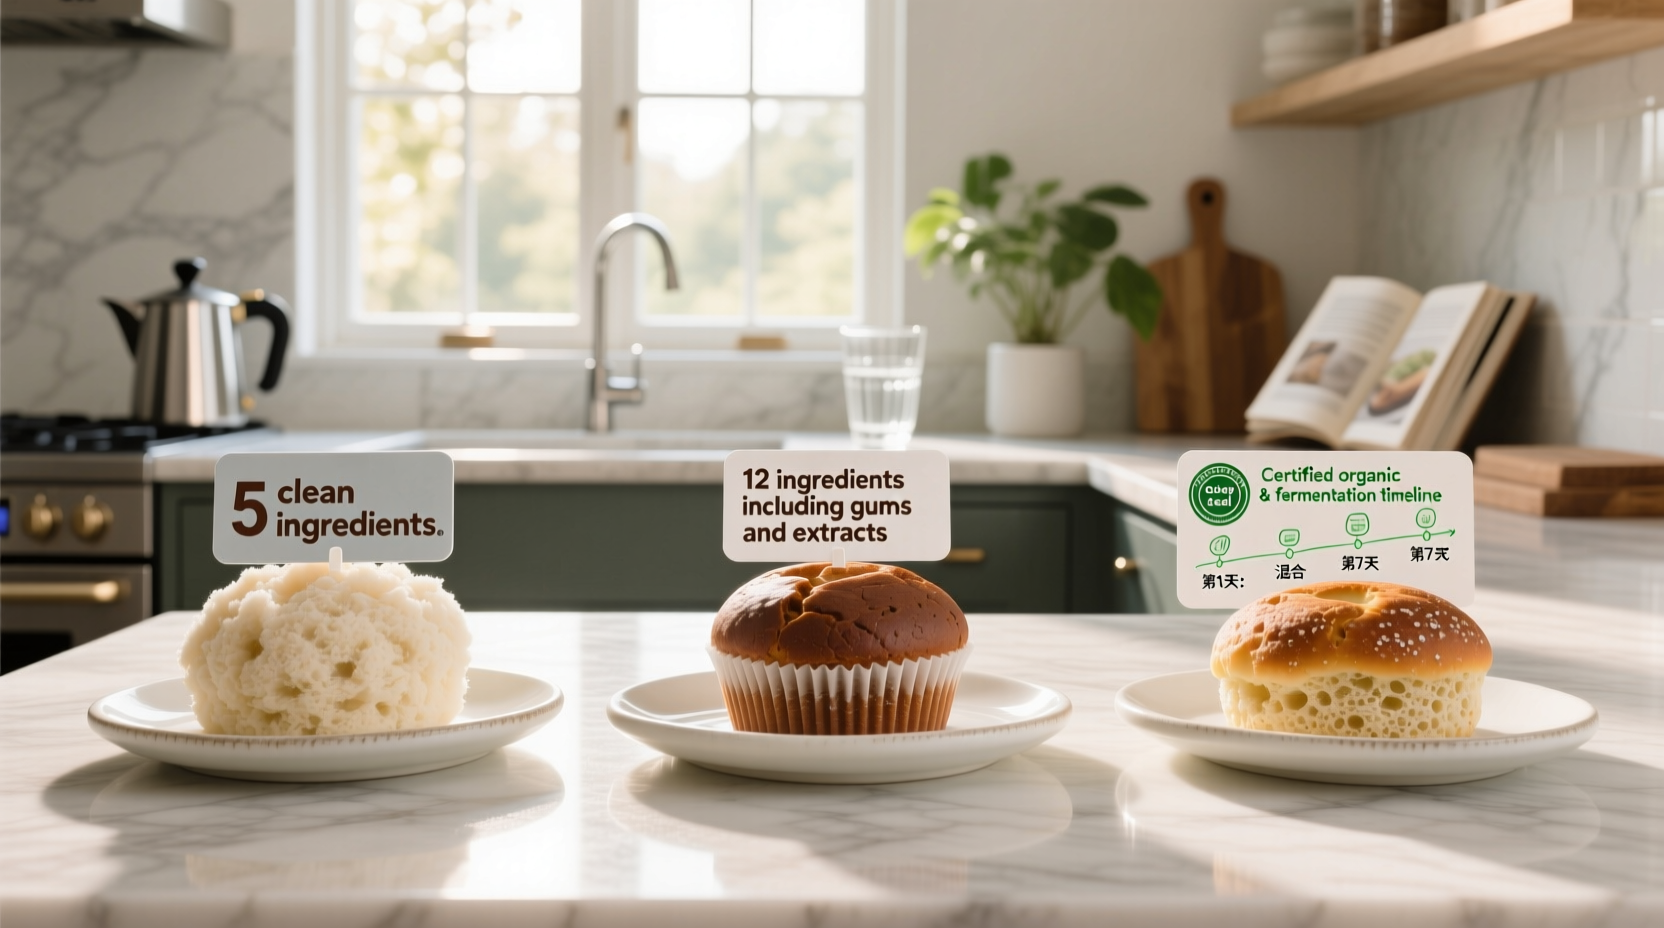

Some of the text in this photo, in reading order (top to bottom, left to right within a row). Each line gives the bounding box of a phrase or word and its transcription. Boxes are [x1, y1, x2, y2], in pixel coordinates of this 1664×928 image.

[742, 468, 904, 494] 12 ingredients
[1261, 466, 1333, 482] Certified
[1338, 466, 1401, 486] organic
[1259, 486, 1443, 502] & fermentation timeline
[232, 478, 354, 537] 5 clean
[742, 495, 912, 521] including gums
[742, 521, 887, 542] and extracts
